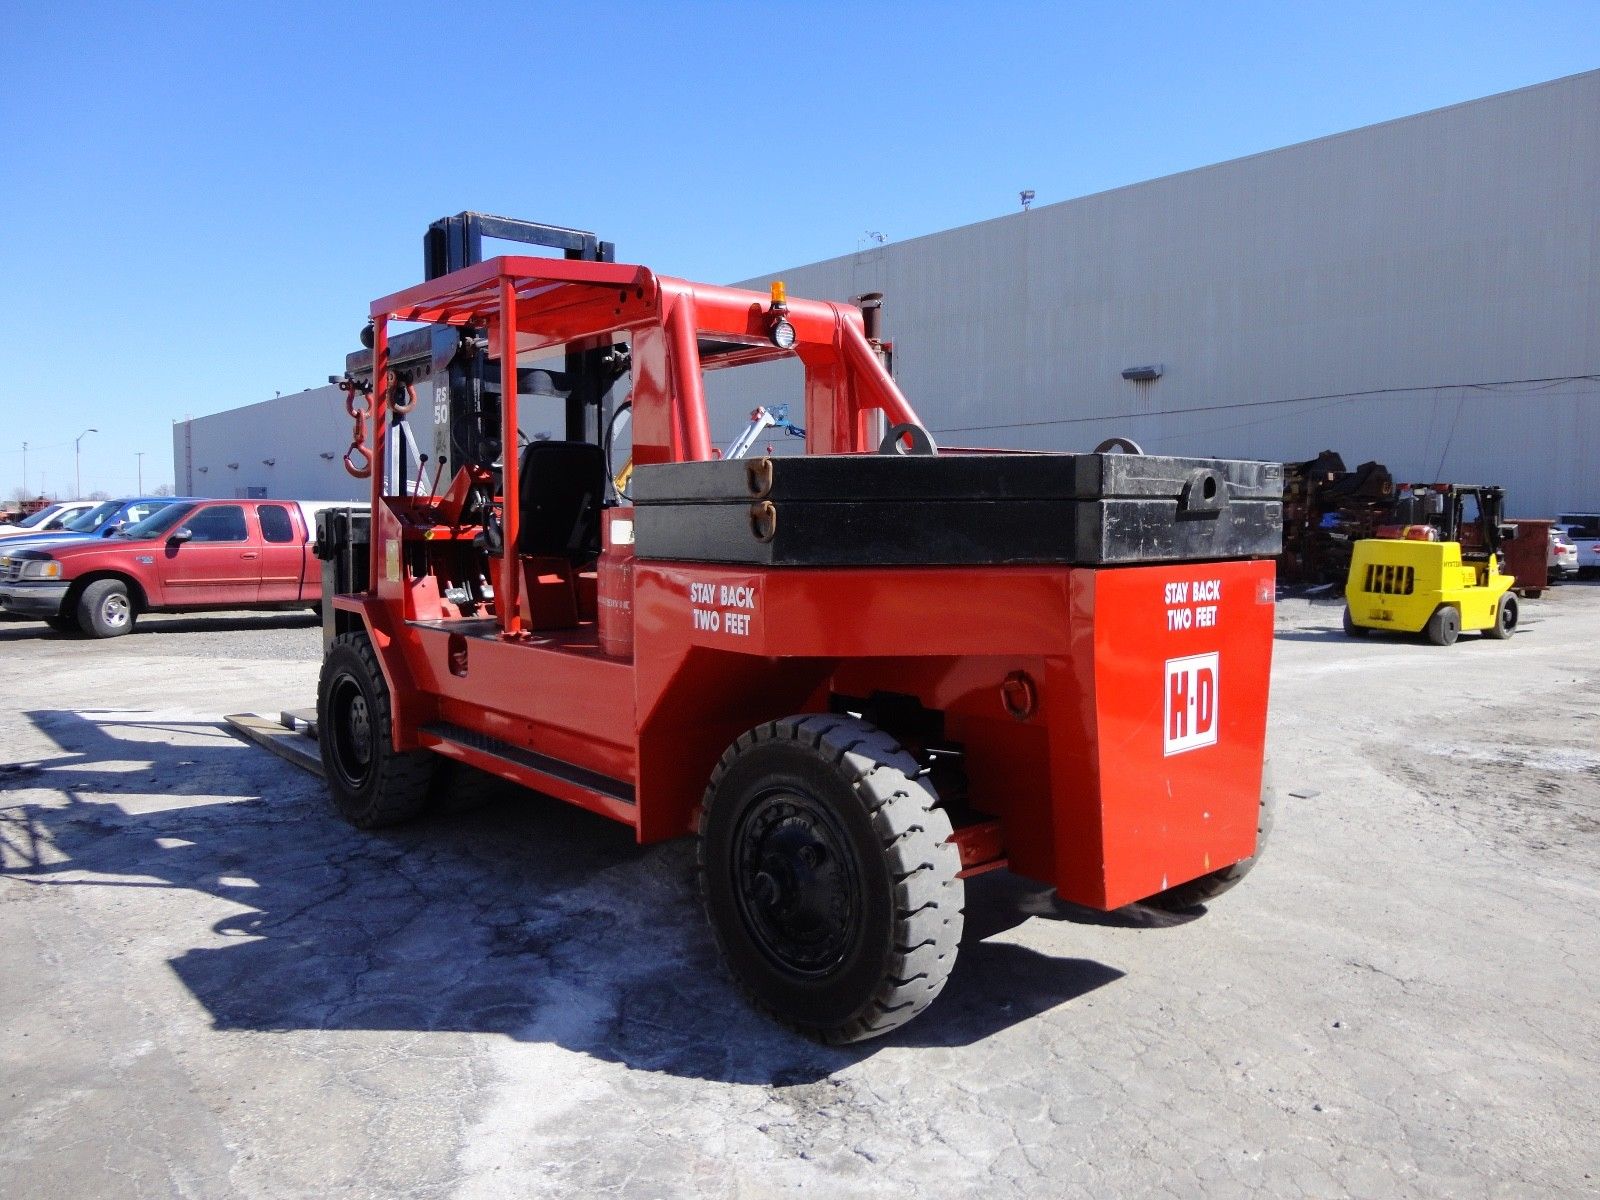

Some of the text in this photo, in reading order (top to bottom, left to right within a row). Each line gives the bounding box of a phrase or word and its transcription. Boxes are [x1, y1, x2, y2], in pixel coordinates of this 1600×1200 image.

[435, 386, 447, 403] RS
[434, 404, 448, 425] 50
[690, 582, 755, 609] STAY BACK
[1164, 579, 1221, 605] STAY BACK
[693, 608, 751, 636] TWO FEET
[1167, 605, 1218, 631] TWO FEET
